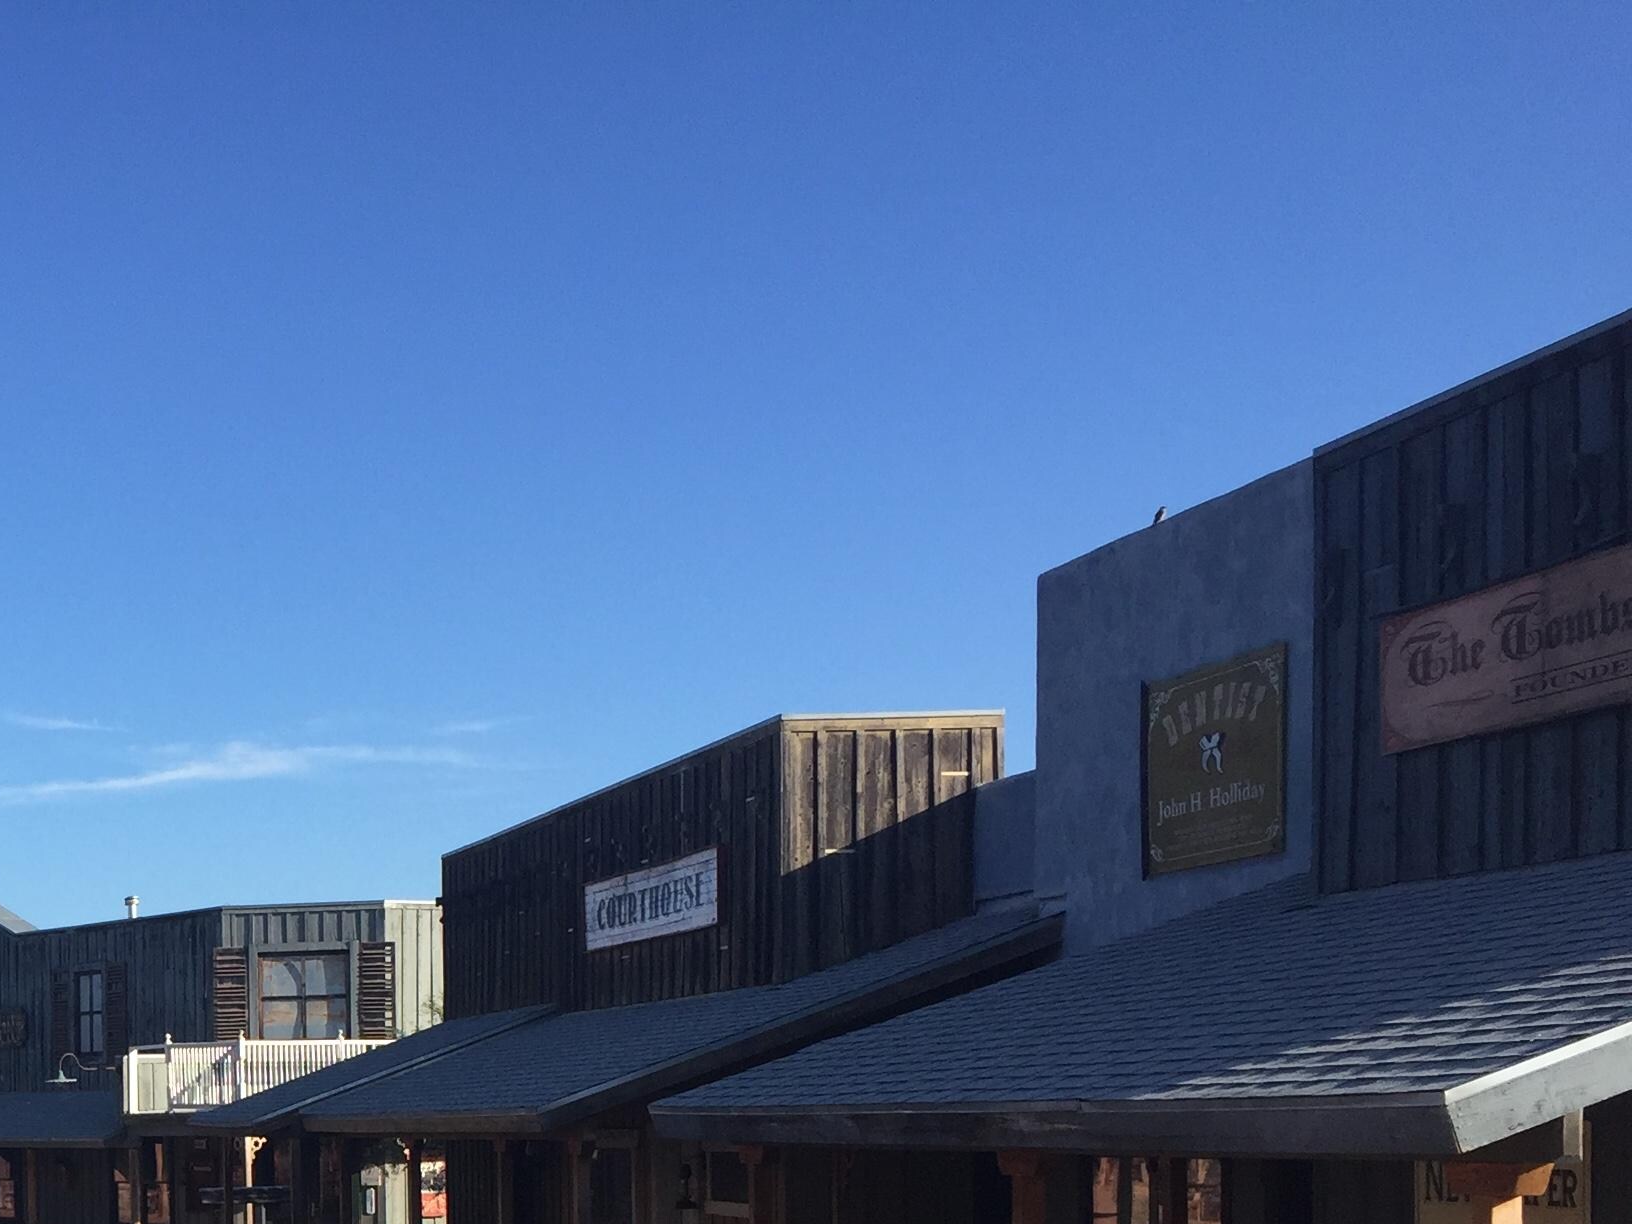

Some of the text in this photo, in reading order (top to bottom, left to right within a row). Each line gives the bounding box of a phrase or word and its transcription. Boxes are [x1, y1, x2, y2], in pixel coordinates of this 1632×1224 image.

[1400, 621, 1486, 686] The
[1163, 681, 1266, 746] DENTIST
[1157, 800, 1187, 827] John
[1209, 780, 1265, 808] Holliday
[597, 871, 705, 930] COURTHOUSE
